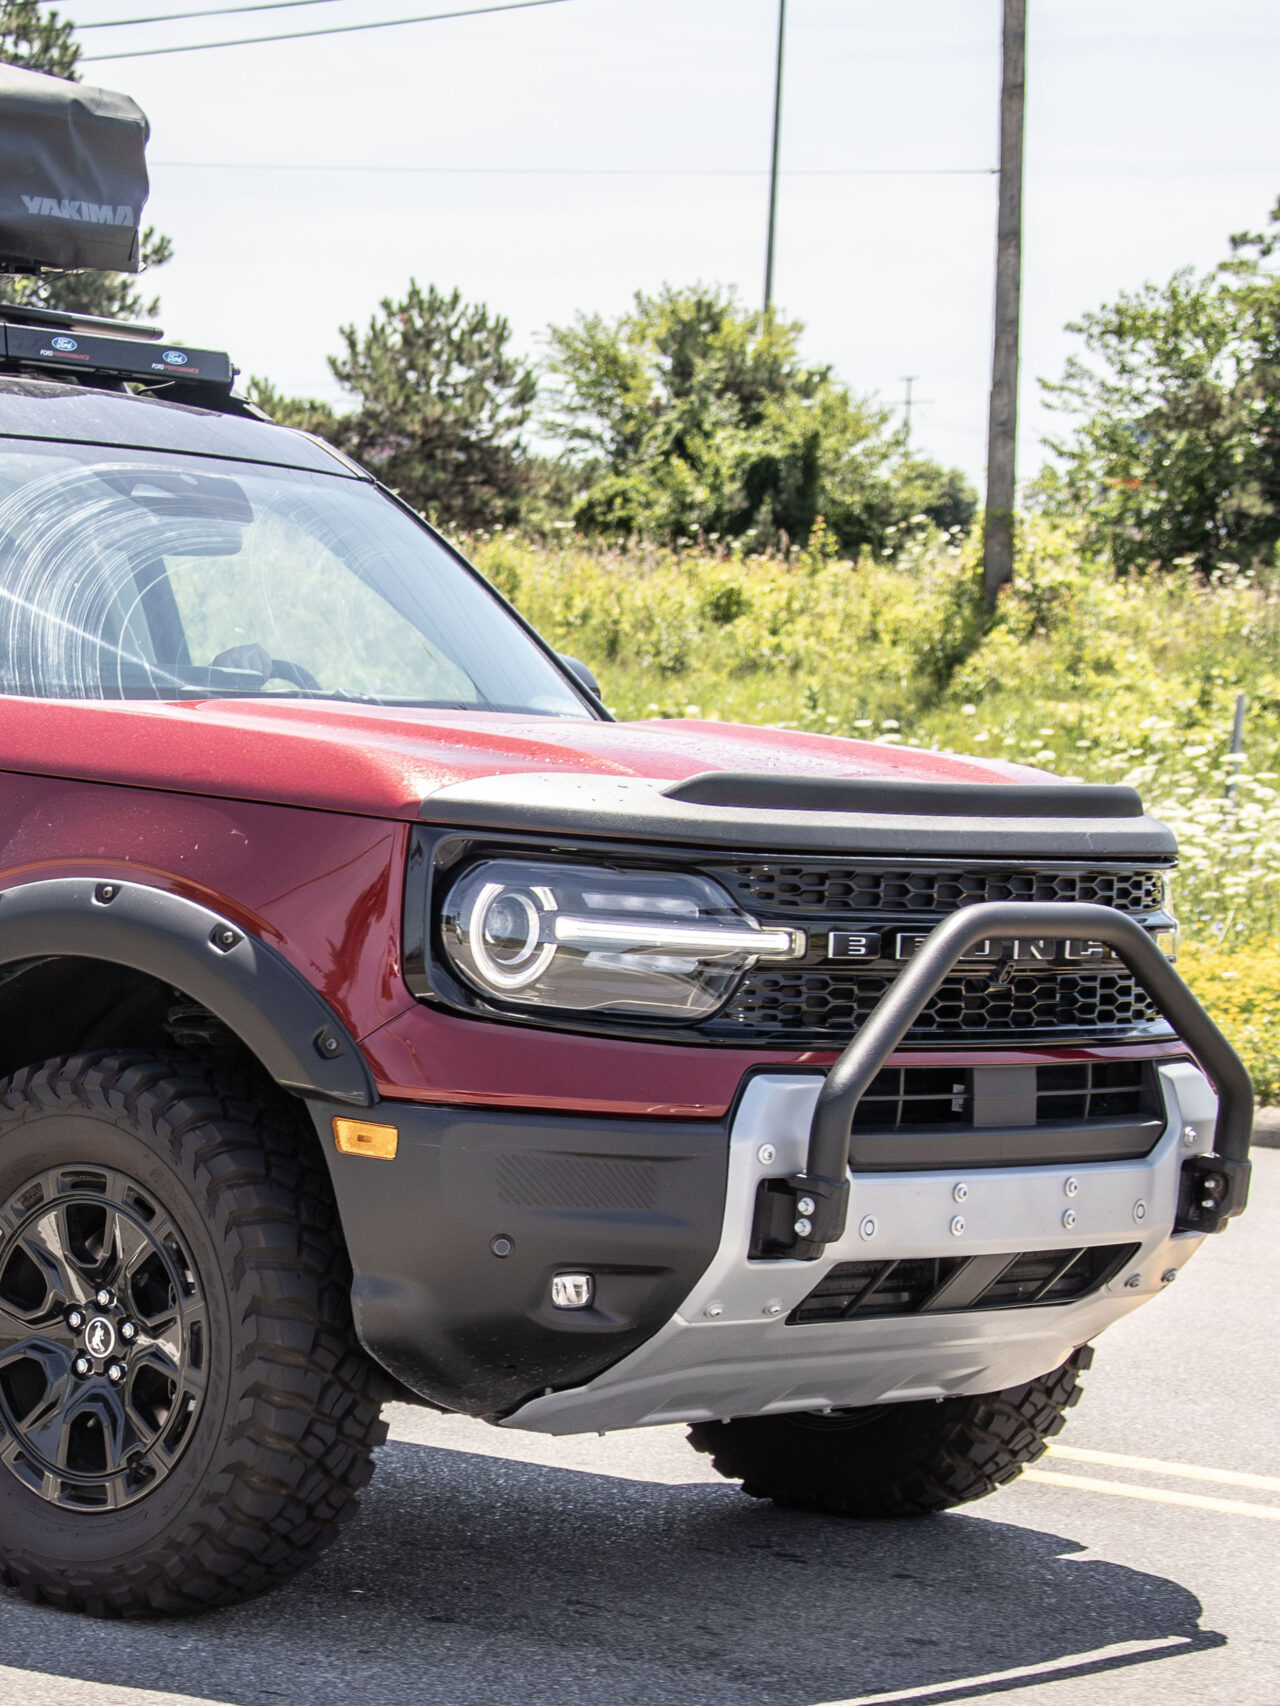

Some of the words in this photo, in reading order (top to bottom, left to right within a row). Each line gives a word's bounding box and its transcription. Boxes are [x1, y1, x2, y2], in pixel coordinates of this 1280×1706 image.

[21, 195, 135, 227] YAKIMA
[55, 338, 74, 350] Ford
[166, 352, 184, 363] Ford
